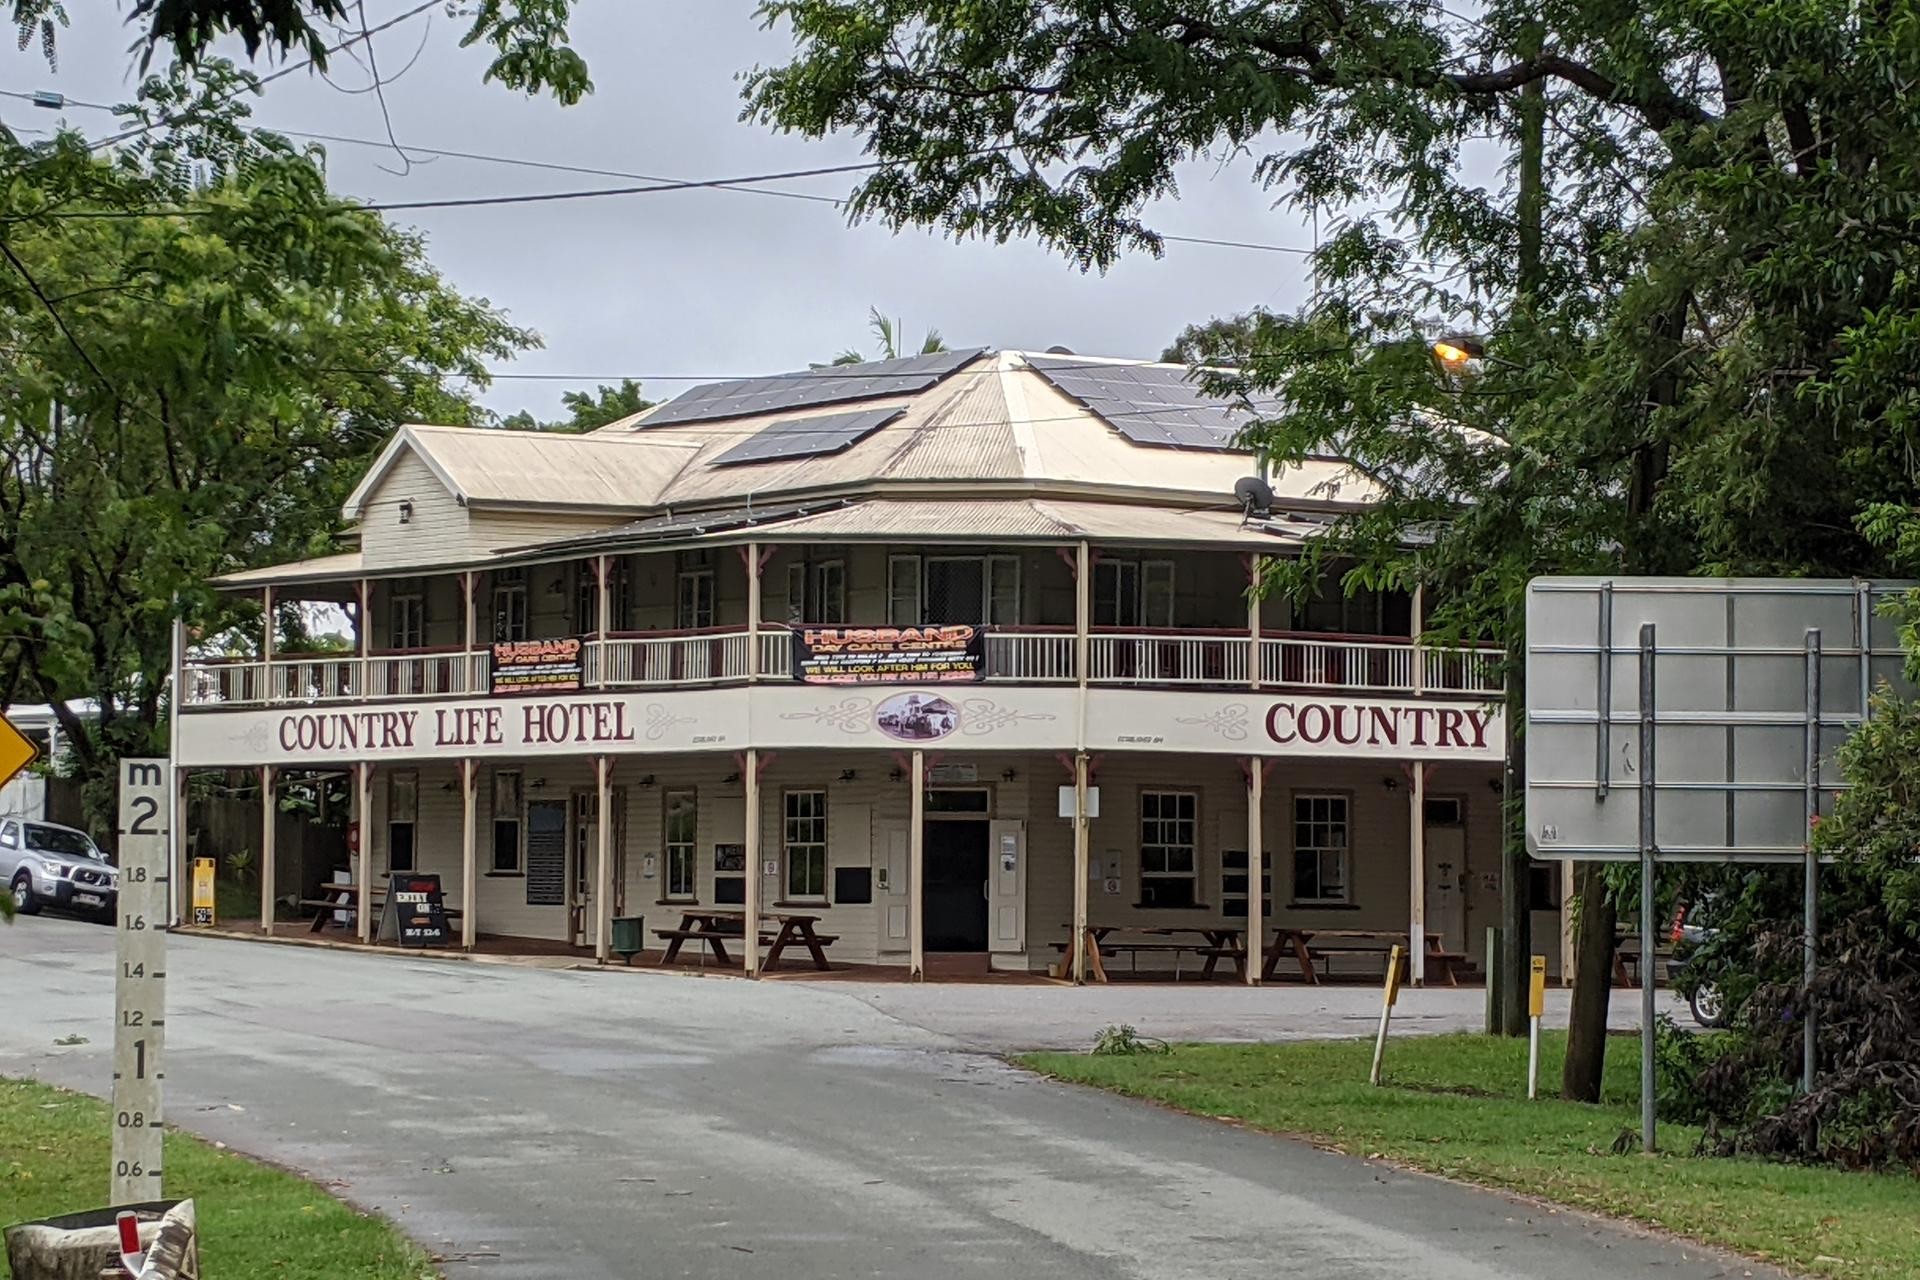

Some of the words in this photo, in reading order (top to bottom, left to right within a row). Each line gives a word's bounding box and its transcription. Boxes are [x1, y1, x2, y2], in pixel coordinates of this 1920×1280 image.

[804, 625, 974, 645] HUSBAND
[494, 639, 580, 657] HUSBAND
[811, 644, 842, 653] DAY
[847, 643, 893, 651] CARE
[899, 641, 967, 650] CENTRE
[805, 666, 821, 674] WE
[823, 665, 846, 673] WILL
[848, 665, 875, 673] LOOK
[876, 664, 909, 672] AFTER
[910, 663, 928, 671] HIM
[930, 662, 950, 670] FOR
[279, 709, 419, 752] COUNTRY
[434, 706, 504, 746] LIFE
[521, 701, 635, 744] HOTEL
[1265, 702, 1490, 749] COUNTRY
[128, 762, 162, 786] m
[130, 795, 159, 835] 2
[125, 866, 147, 883] 1.8
[125, 914, 146, 931] 1.6
[123, 962, 145, 979] 1.4
[122, 1010, 144, 1027] 1.2
[133, 1039, 145, 1079] 1
[117, 1111, 144, 1128] 0.8
[116, 1160, 143, 1177] 0.6
